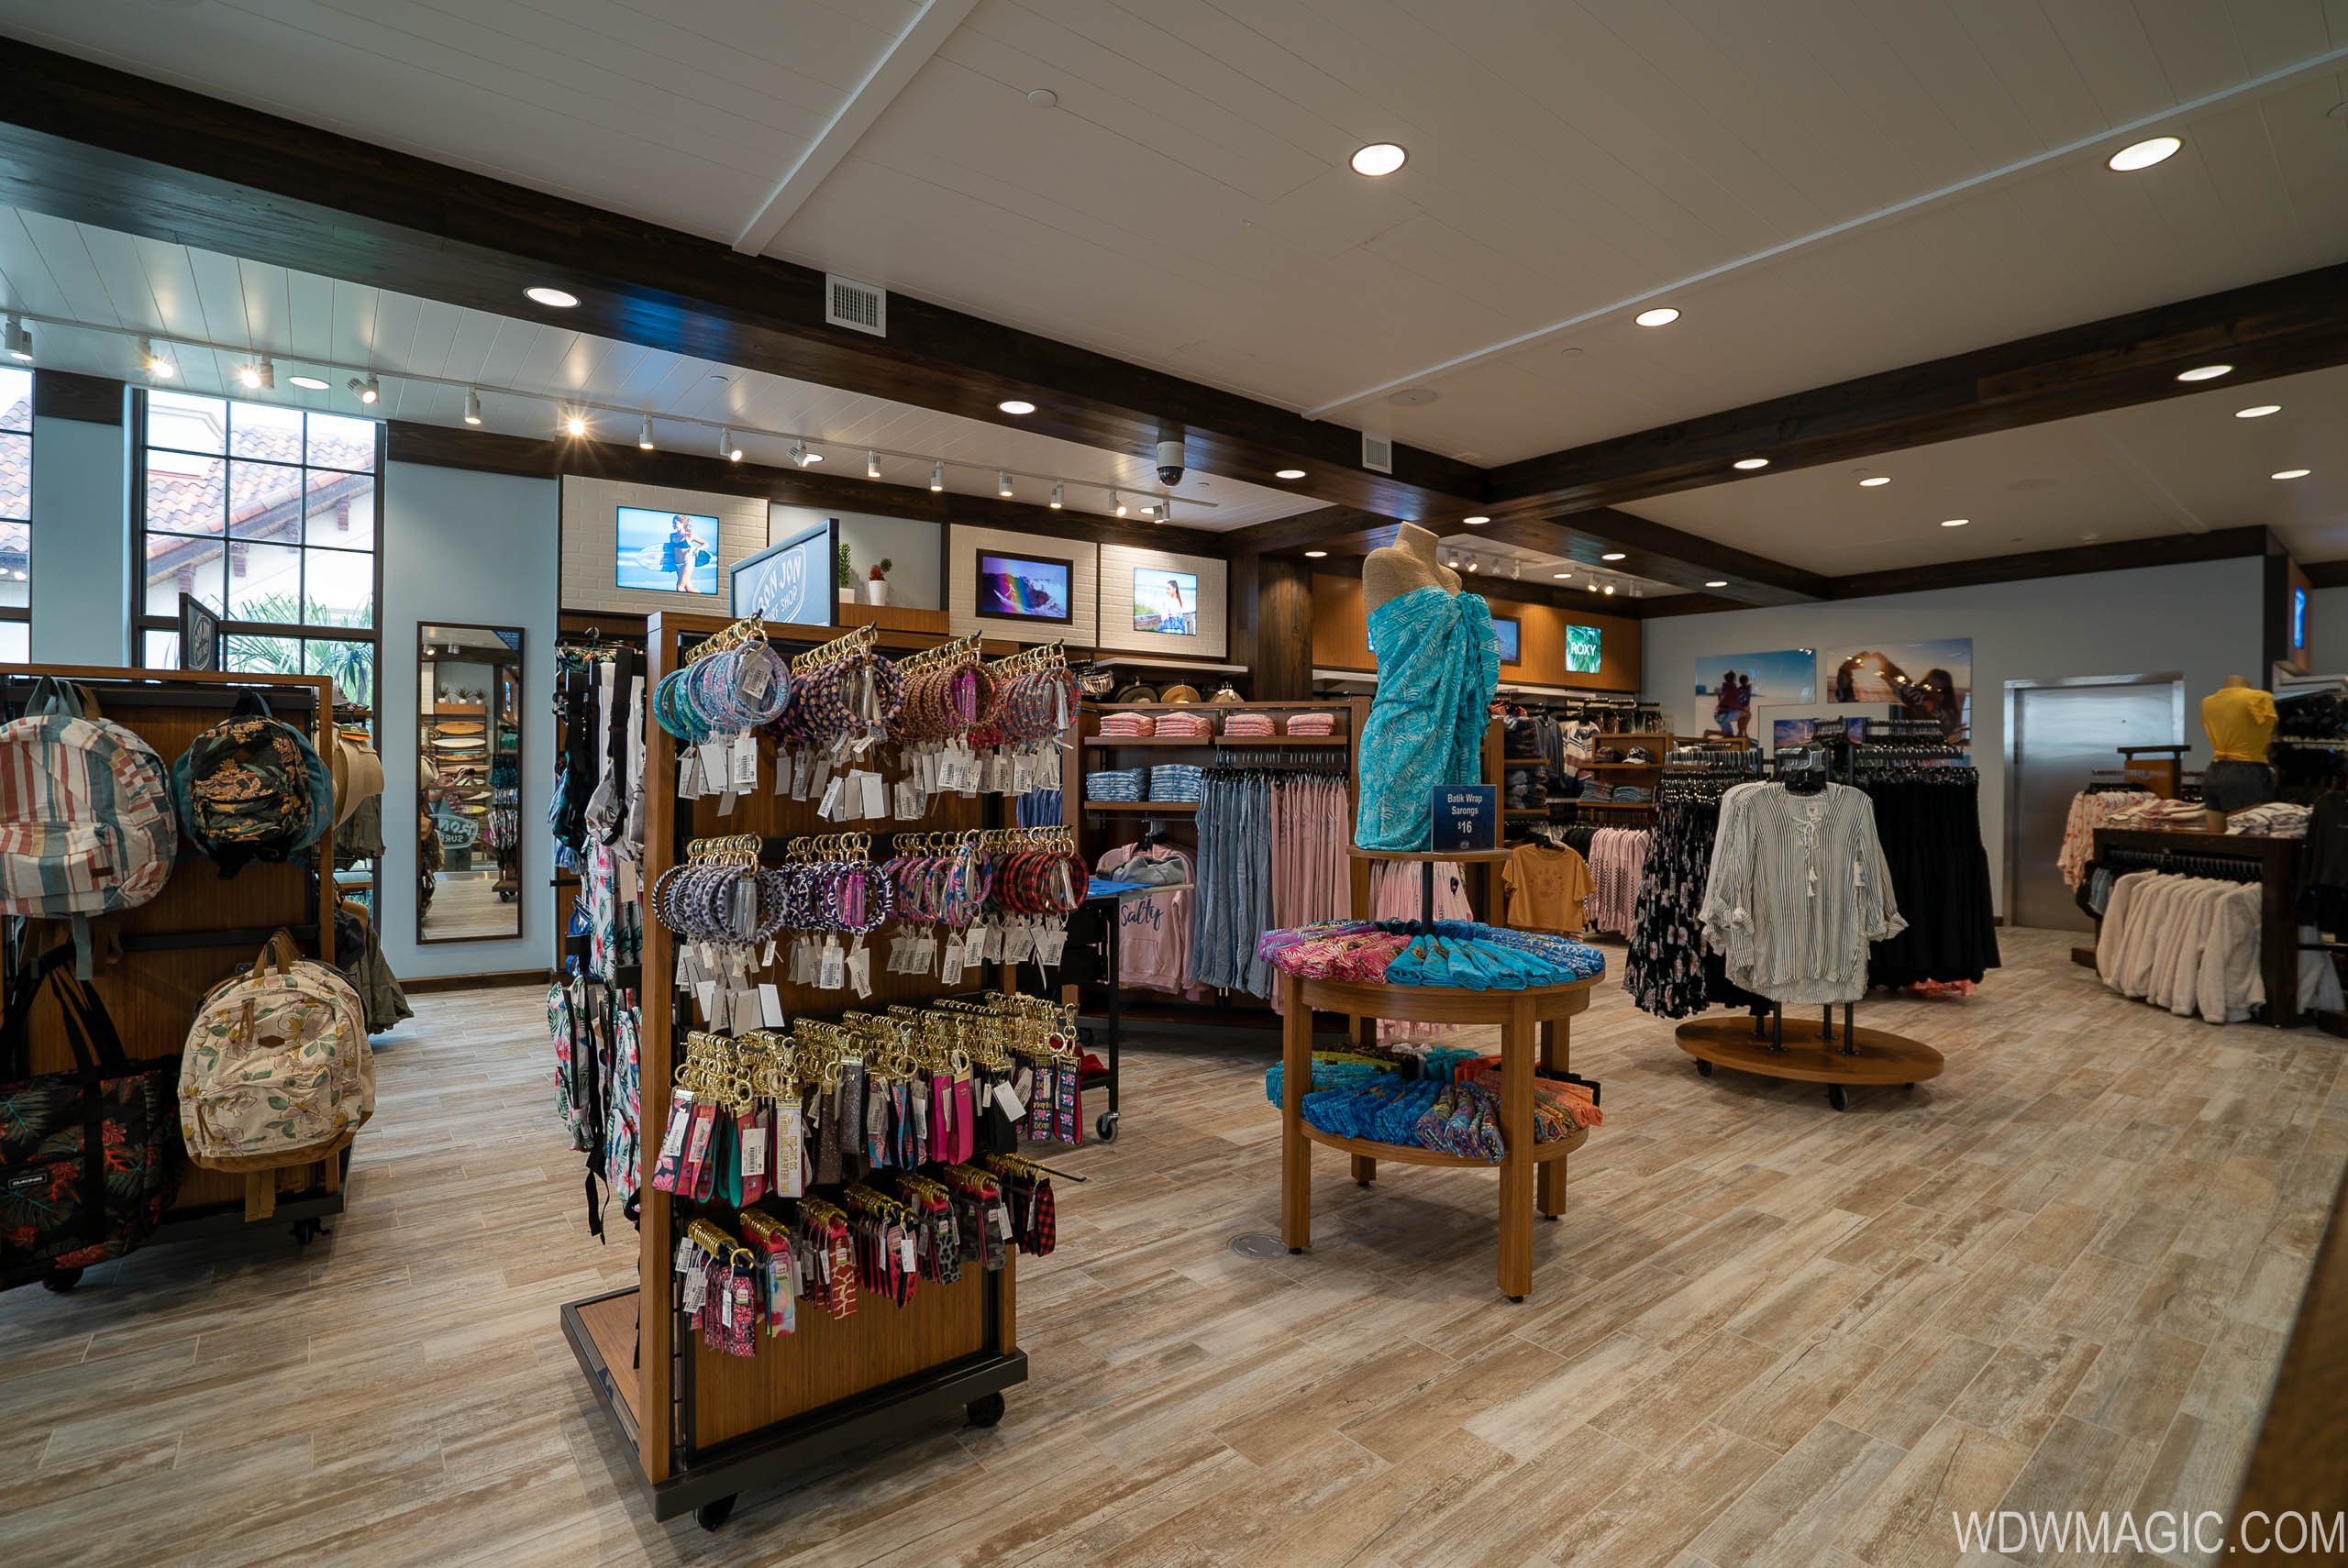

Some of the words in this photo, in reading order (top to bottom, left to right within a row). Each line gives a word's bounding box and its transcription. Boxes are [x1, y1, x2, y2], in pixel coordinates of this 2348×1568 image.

[759, 569, 777, 613] RON
[780, 556, 801, 589] JON
[781, 585, 797, 613] SHOP
[1570, 642, 1596, 657] ROXY
[1447, 793, 1464, 803] Batik
[1466, 794, 1482, 804] Wrap
[1451, 806, 1479, 816] Sarongs
[1457, 821, 1472, 834] $16
[1121, 896, 1164, 931] Salty
